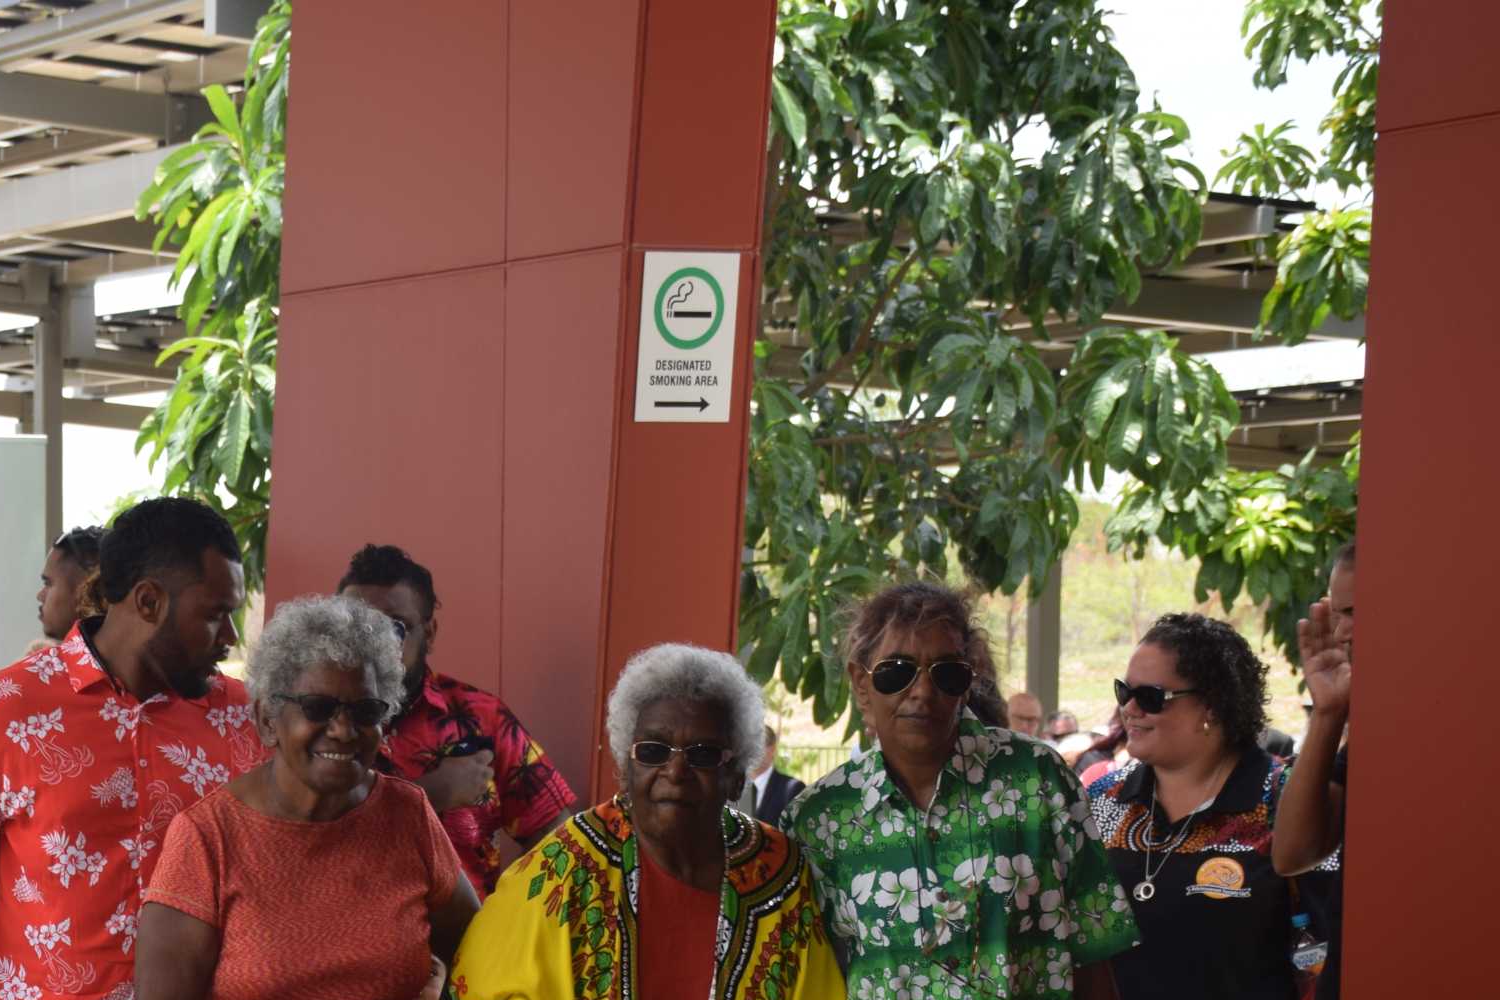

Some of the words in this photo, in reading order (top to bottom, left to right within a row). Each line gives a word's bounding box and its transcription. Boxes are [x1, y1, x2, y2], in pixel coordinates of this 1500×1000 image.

[655, 360, 712, 371] DESIGNATED
[649, 375, 692, 386] SMOKING
[695, 375, 718, 386] AREA
